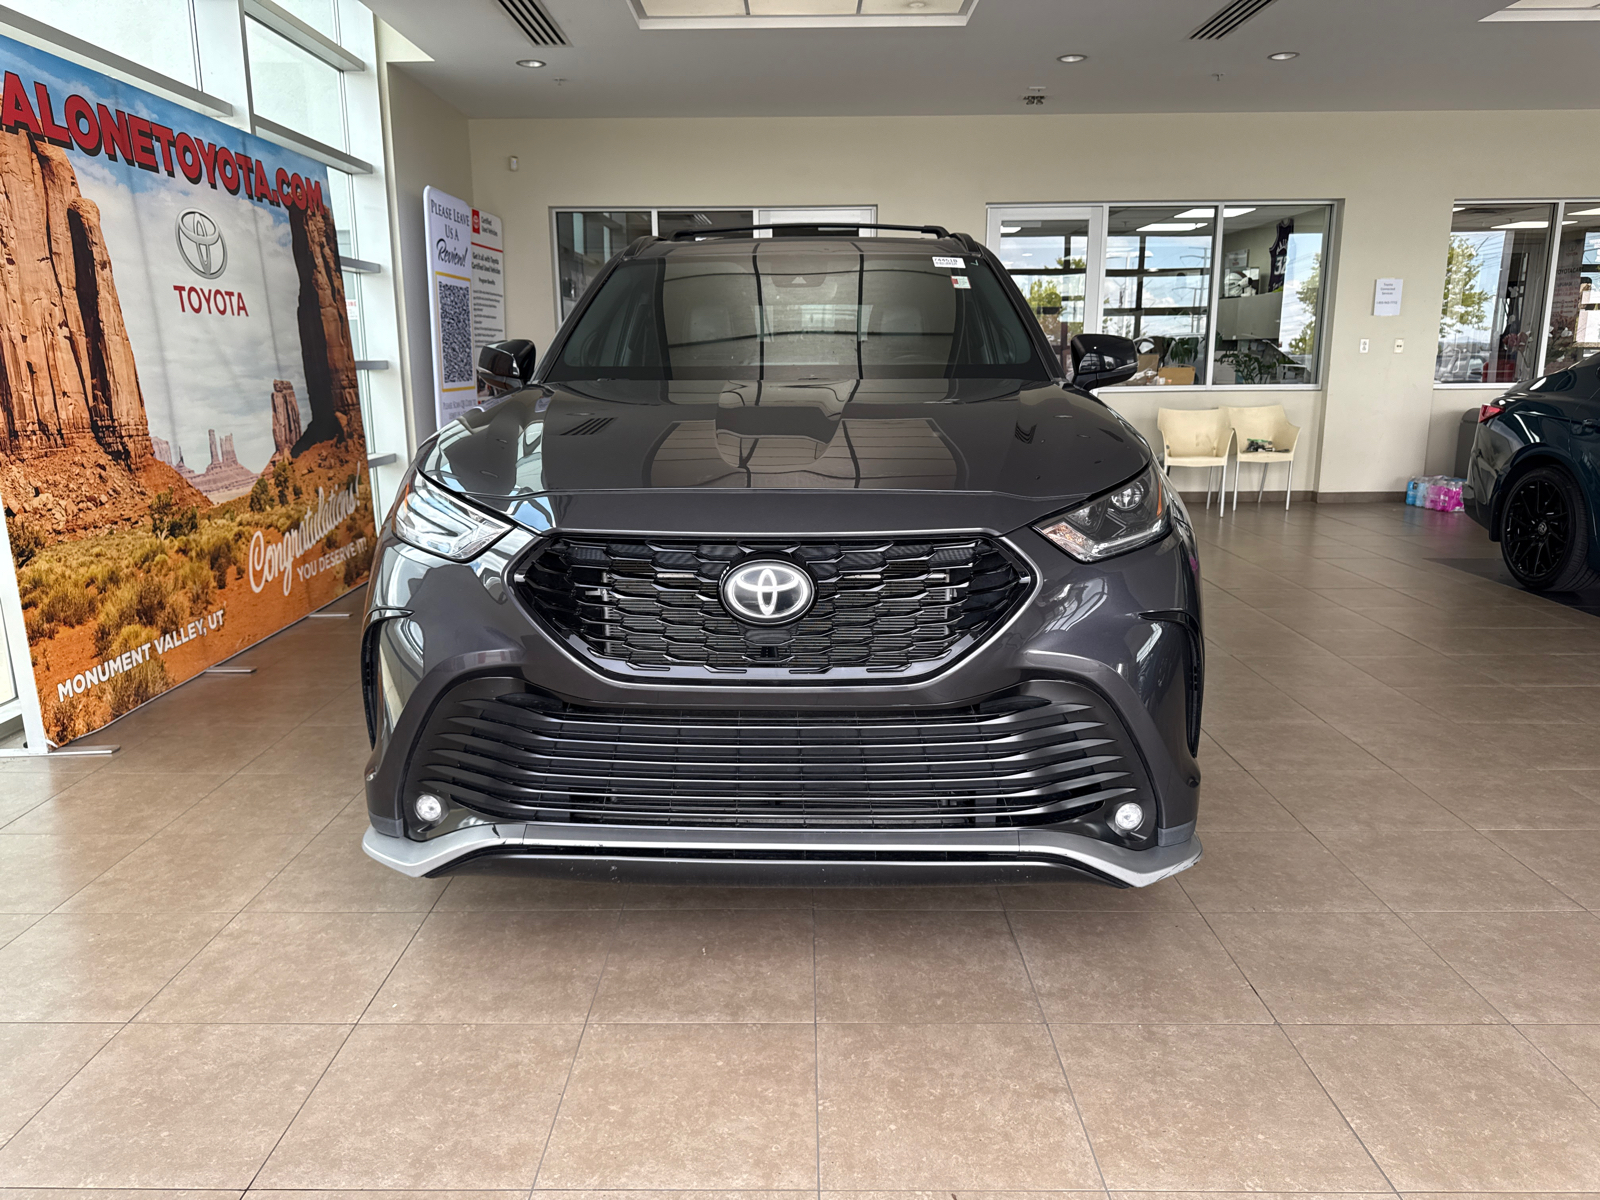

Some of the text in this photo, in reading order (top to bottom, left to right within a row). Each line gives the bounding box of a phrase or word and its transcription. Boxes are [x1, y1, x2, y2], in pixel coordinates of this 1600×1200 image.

[430, 198, 470, 228] PLEASE LEAVE
[435, 237, 469, 268] Review!
[173, 284, 250, 318] TOYOTA
[248, 461, 361, 597] Congratulations!
[296, 536, 368, 582] YOU DESERVE IT!
[56, 608, 225, 703] MONUMENT VALLEY, UT
